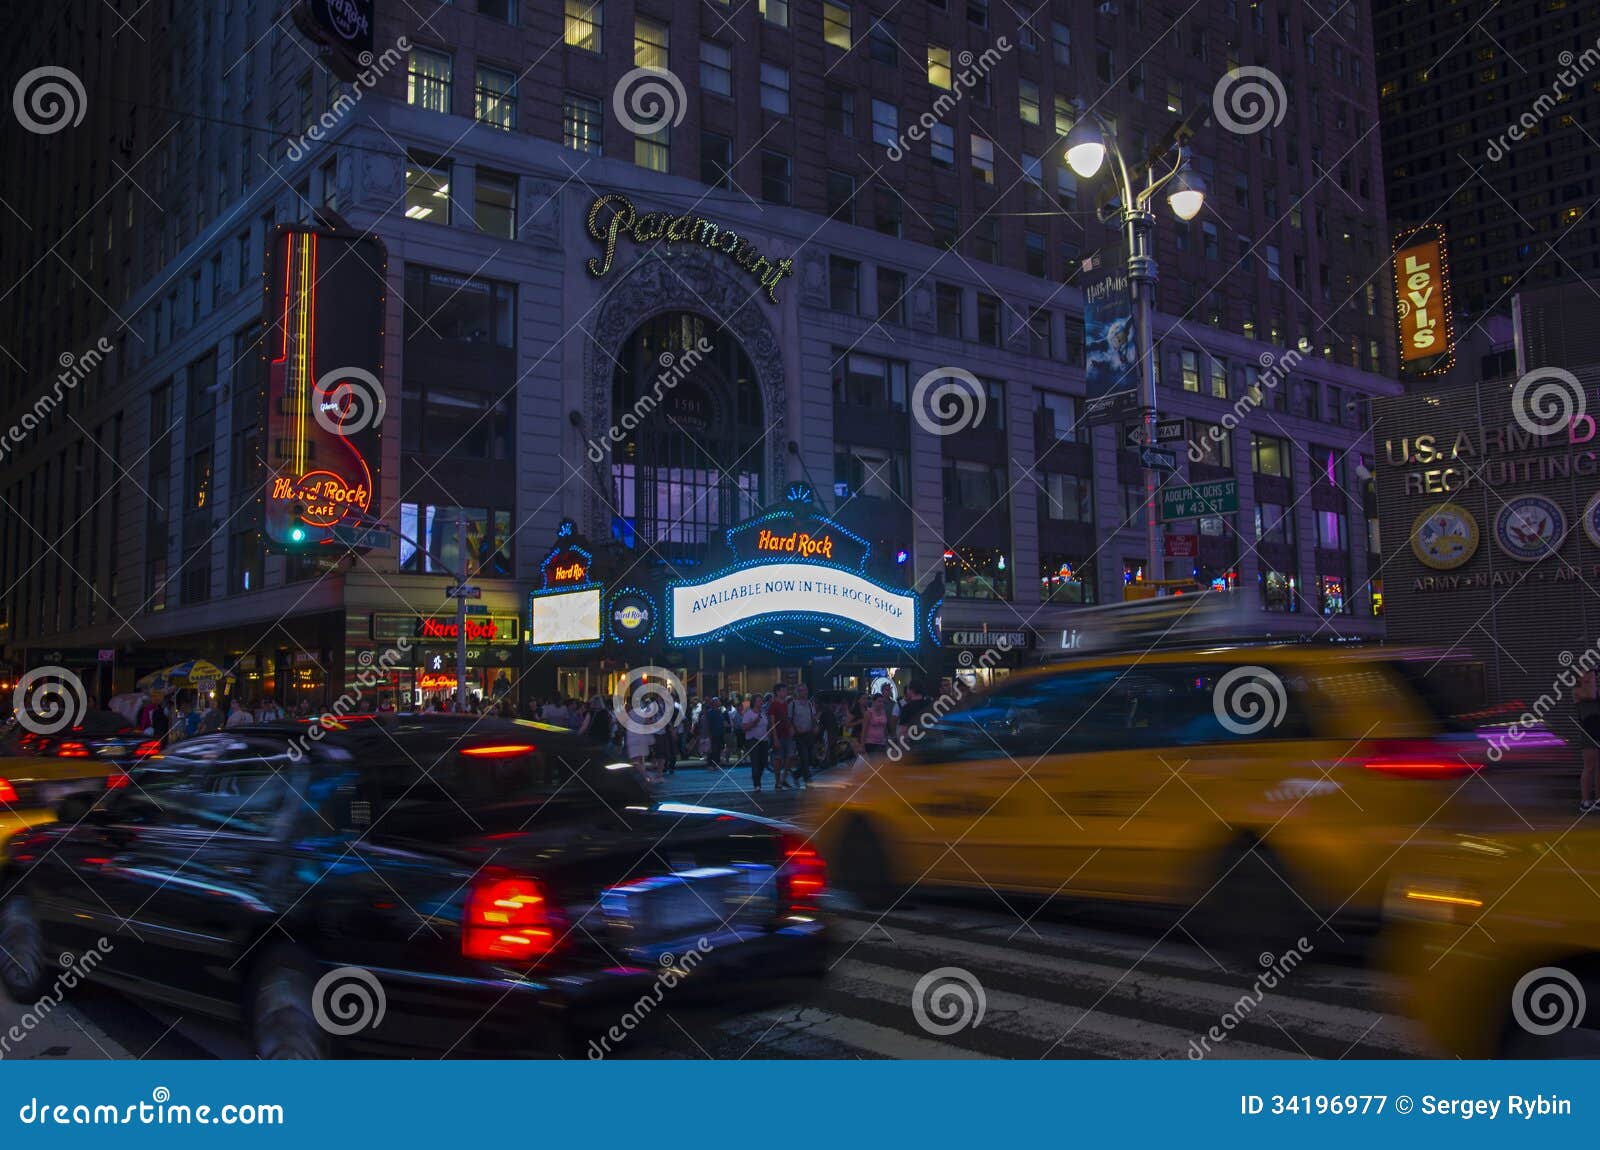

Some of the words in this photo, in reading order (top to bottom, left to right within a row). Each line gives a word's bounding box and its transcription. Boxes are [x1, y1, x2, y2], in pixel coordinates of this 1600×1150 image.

[586, 193, 793, 304] Paramount
[1404, 451, 1597, 496] RECRUITING
[323, 480, 367, 508] Rock
[1164, 488, 1193, 503] ADOLPH
[1203, 484, 1222, 498] OCHS
[1225, 482, 1235, 495] ST
[1176, 503, 1185, 516] W
[1190, 501, 1205, 513] 43
[1210, 499, 1224, 512] ST
[758, 529, 796, 551] Hard
[798, 532, 832, 558] Rock
[555, 566, 573, 580] Hard
[1414, 575, 1460, 591] ARMY
[692, 583, 761, 613] AVAILABLE
[765, 580, 795, 593] NOW
[800, 580, 812, 592] IN
[816, 581, 839, 595] THE
[842, 587, 872, 605] ROCK
[873, 596, 903, 618] SHOP
[465, 617, 497, 641] Rock
